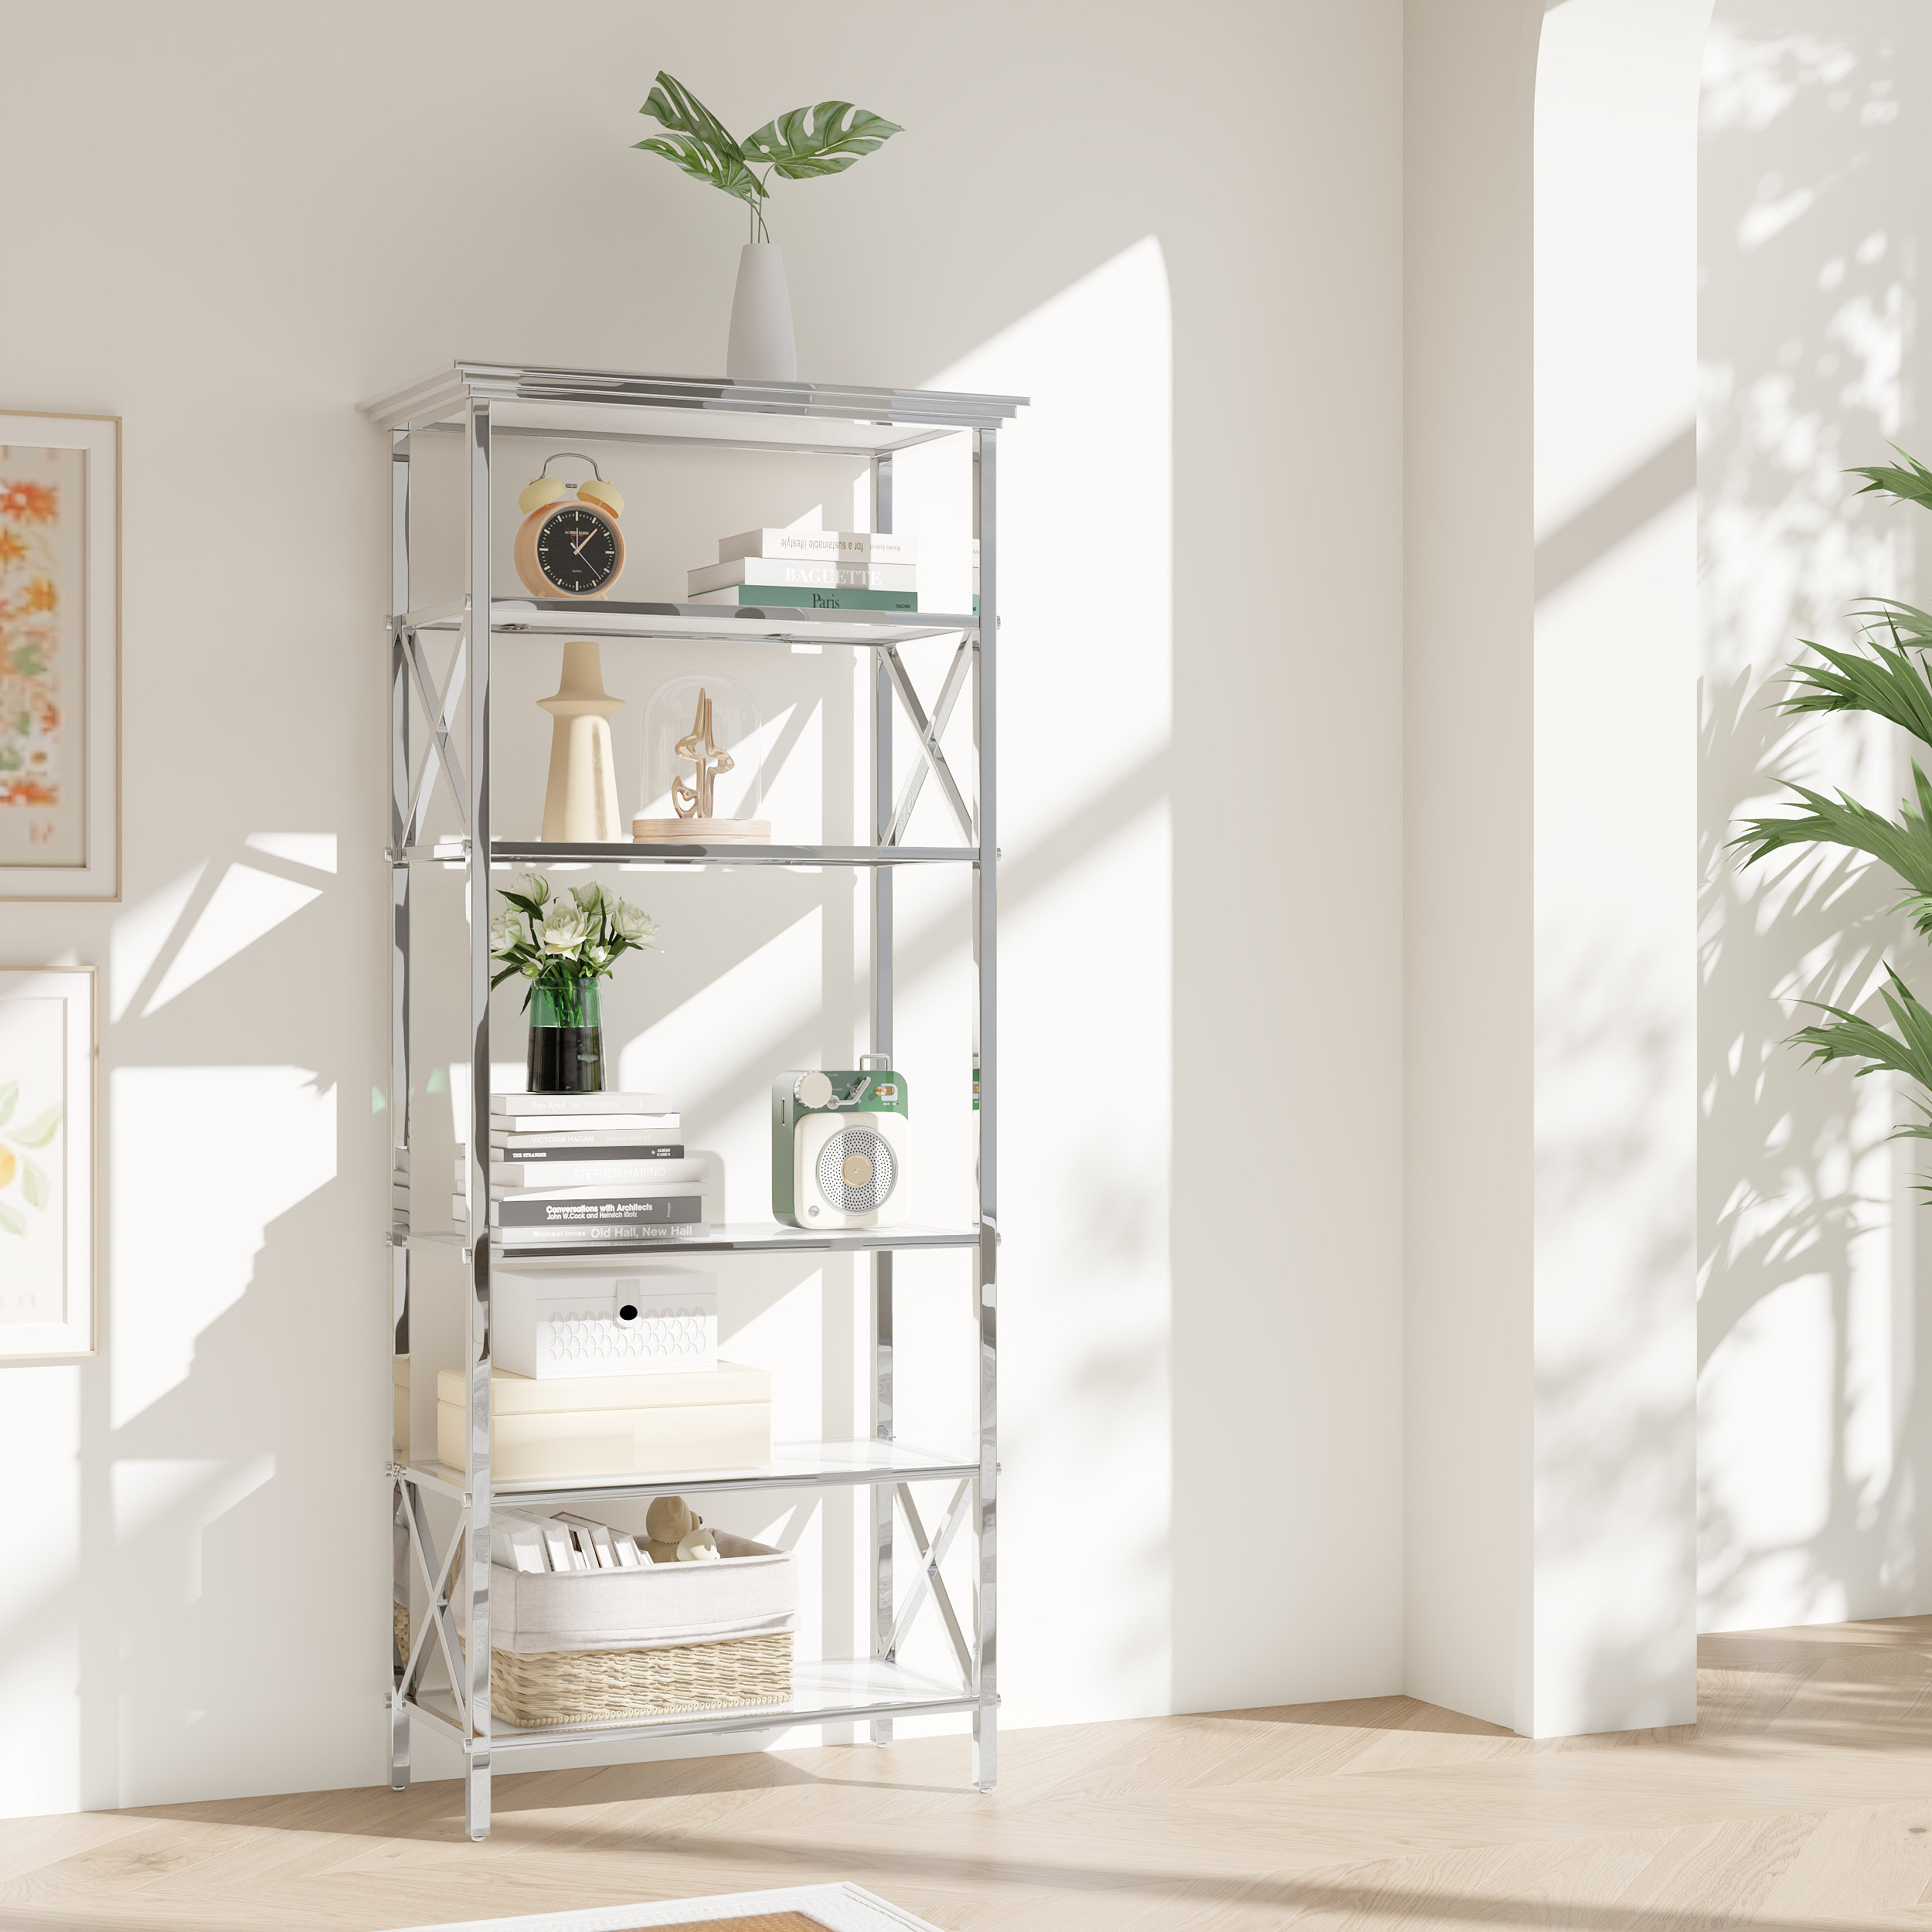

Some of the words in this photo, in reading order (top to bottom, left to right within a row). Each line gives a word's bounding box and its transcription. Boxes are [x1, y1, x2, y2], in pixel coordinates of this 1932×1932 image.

[781, 536, 807, 549] lifestyle
[808, 539, 847, 550] sustainable
[854, 542, 864, 553] for
[785, 567, 882, 586] BAGUETTE
[811, 593, 840, 609] Paris
[548, 1101, 566, 1110] Arad
[573, 1168, 621, 1180] STEPHEN
[624, 1166, 666, 1179] MARINO
[546, 1204, 598, 1214] Conversations
[600, 1204, 614, 1213] with
[617, 1202, 653, 1212] Architects
[590, 1227, 611, 1238] Old
[614, 1227, 639, 1239] Hall,
[642, 1226, 667, 1236] New
[671, 1225, 692, 1236] Hall
